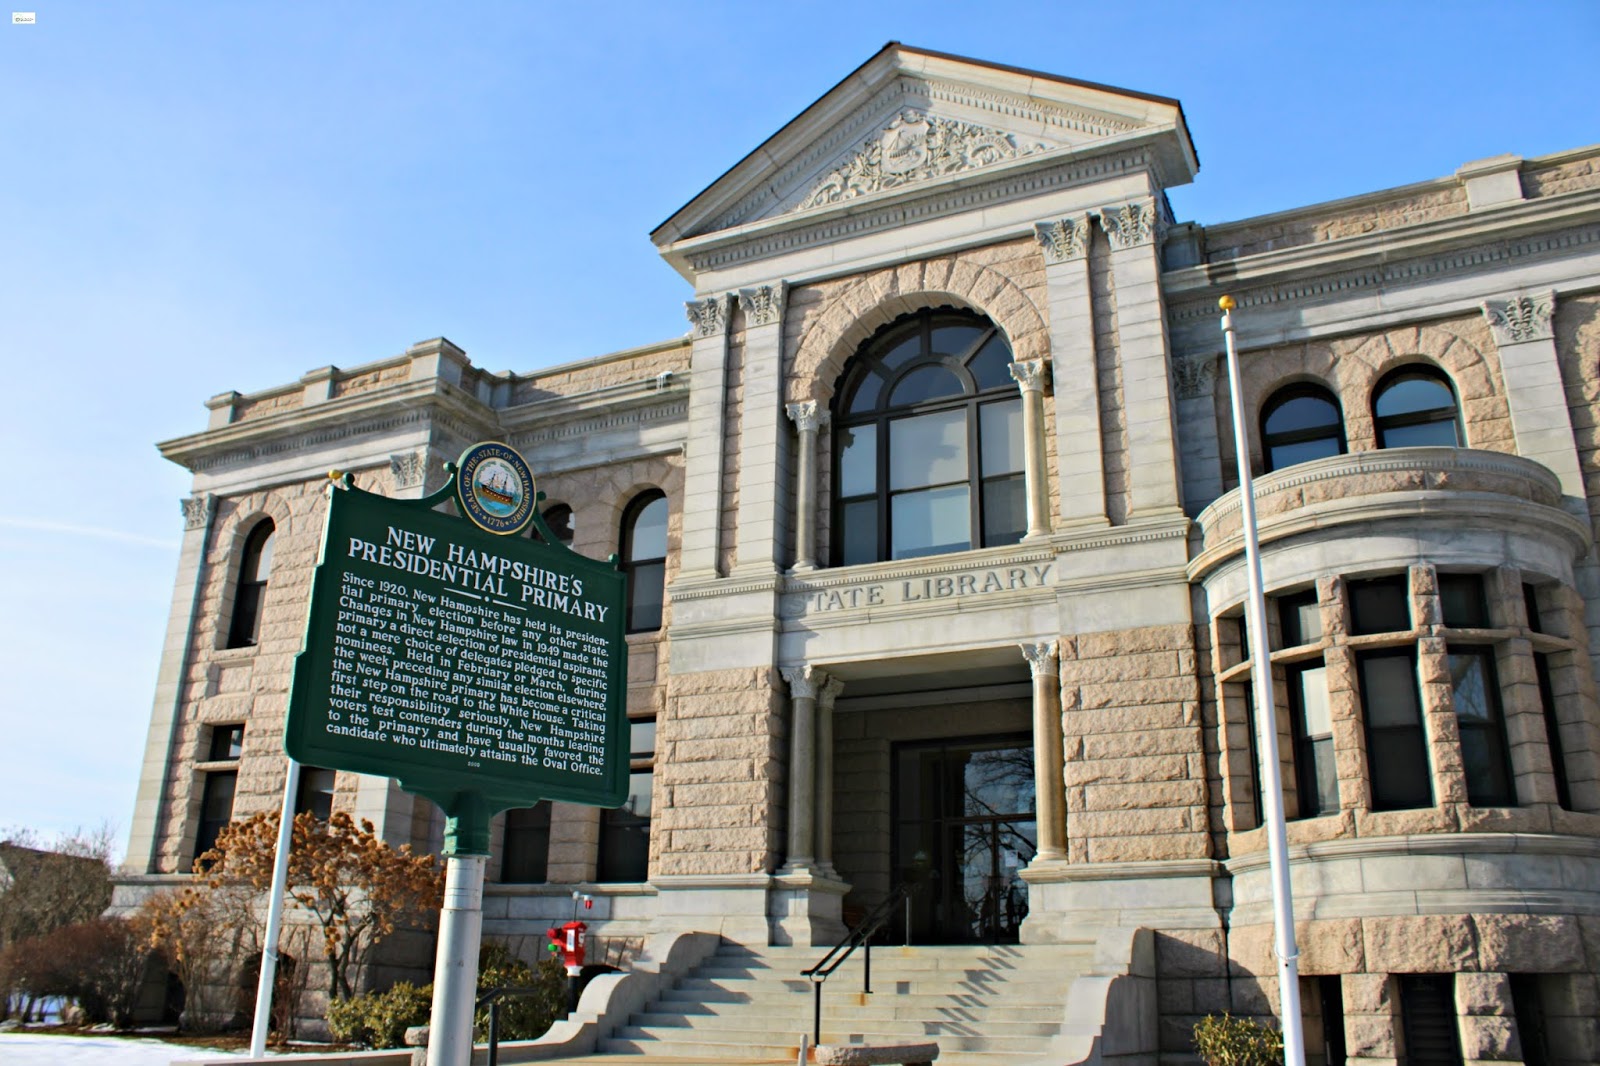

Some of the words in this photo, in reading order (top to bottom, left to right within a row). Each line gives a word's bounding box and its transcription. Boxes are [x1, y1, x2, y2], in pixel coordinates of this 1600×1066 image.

[463, 475, 471, 487] OF
[465, 457, 478, 472] THE
[478, 448, 500, 458] STATE
[502, 452, 513, 462] OF
[513, 460, 528, 479] NEW
[465, 490, 481, 514] SEAL
[487, 516, 505, 528] 1776
[511, 480, 531, 524] HAMPSHIRE
[347, 537, 508, 597] PRESIDENTIAL
[520, 584, 609, 623] PRIMARY
[386, 526, 436, 555] NEW
[447, 543, 582, 597] HAMPSHIRE'S
[901, 564, 1052, 601] LIBRARY
[339, 595, 392, 617] Changes
[396, 609, 407, 621] in
[412, 612, 436, 627] New
[440, 619, 498, 642] Hampshire
[501, 634, 518, 646] law
[522, 638, 532, 650] in
[537, 642, 560, 656] 1949
[562, 651, 589, 663] made
[592, 656, 608, 668] the
[341, 584, 363, 598] tial
[369, 593, 419, 613] primary
[428, 606, 474, 625] election
[480, 617, 516, 634] before
[521, 629, 542, 642] any
[549, 636, 577, 649] other
[582, 644, 609, 657] state.
[342, 571, 374, 588] Since
[412, 588, 436, 603] New
[440, 595, 500, 620] Hampshire
[503, 611, 521, 625] has
[524, 617, 546, 631] held
[549, 623, 561, 635] its
[565, 630, 609, 646] presiden-
[336, 622, 356, 634] not
[359, 628, 367, 637] a
[371, 630, 401, 644] mere
[404, 637, 442, 653] choice
[445, 646, 458, 656] of
[460, 649, 512, 668] delegates
[514, 661, 555, 679] pledged
[557, 671, 568, 681] to
[571, 675, 607, 690] specific
[337, 610, 387, 629] primary
[389, 622, 397, 631] a
[399, 623, 433, 639] direct
[436, 633, 485, 651] selection
[488, 644, 500, 654] of
[501, 648, 561, 668] presidential
[332, 658, 353, 671] the
[355, 662, 381, 677] New
[385, 668, 447, 691] Hampshire
[451, 684, 497, 702] primary
[499, 692, 518, 705] has
[521, 696, 560, 713] become
[561, 706, 568, 715] a
[570, 708, 606, 722] critical
[333, 646, 355, 659] the
[359, 652, 389, 670] week
[392, 660, 450, 682] preceding
[452, 672, 473, 685] any
[475, 676, 512, 692] similar
[514, 684, 554, 700] election
[335, 635, 395, 655] nominees.
[406, 648, 434, 664] Held
[440, 655, 451, 668] in
[457, 659, 509, 681] February
[513, 674, 526, 683] or
[573, 685, 607, 703] during
[329, 697, 367, 712] voters
[372, 704, 394, 717] test
[398, 711, 462, 730] contenders
[465, 722, 502, 740] during
[507, 729, 524, 741] the
[527, 734, 564, 748] months
[568, 739, 604, 757] leading
[330, 684, 361, 699] their
[368, 692, 450, 716] responsibility
[520, 719, 542, 732] New
[550, 724, 605, 744] Hampshire
[331, 670, 356, 685] first
[362, 678, 388, 693] step
[390, 684, 405, 695] on
[410, 685, 429, 699] the
[432, 692, 459, 705] road
[463, 697, 474, 708] to
[478, 699, 496, 712] the
[499, 703, 529, 718] White
[532, 709, 565, 725] House.
[571, 717, 605, 735] Taking
[326, 723, 387, 742] candidate
[392, 734, 416, 746] who
[419, 738, 476, 757] ultimately
[479, 749, 517, 762] attains
[521, 754, 538, 766] the
[542, 757, 567, 770] Oval
[570, 761, 603, 775] Office.
[327, 709, 341, 721] to
[349, 713, 369, 726] the
[378, 719, 429, 738] primary
[437, 730, 458, 741] and
[466, 733, 491, 747] have
[498, 741, 537, 756] usually
[544, 746, 581, 762] favored
[586, 754, 604, 767] the
